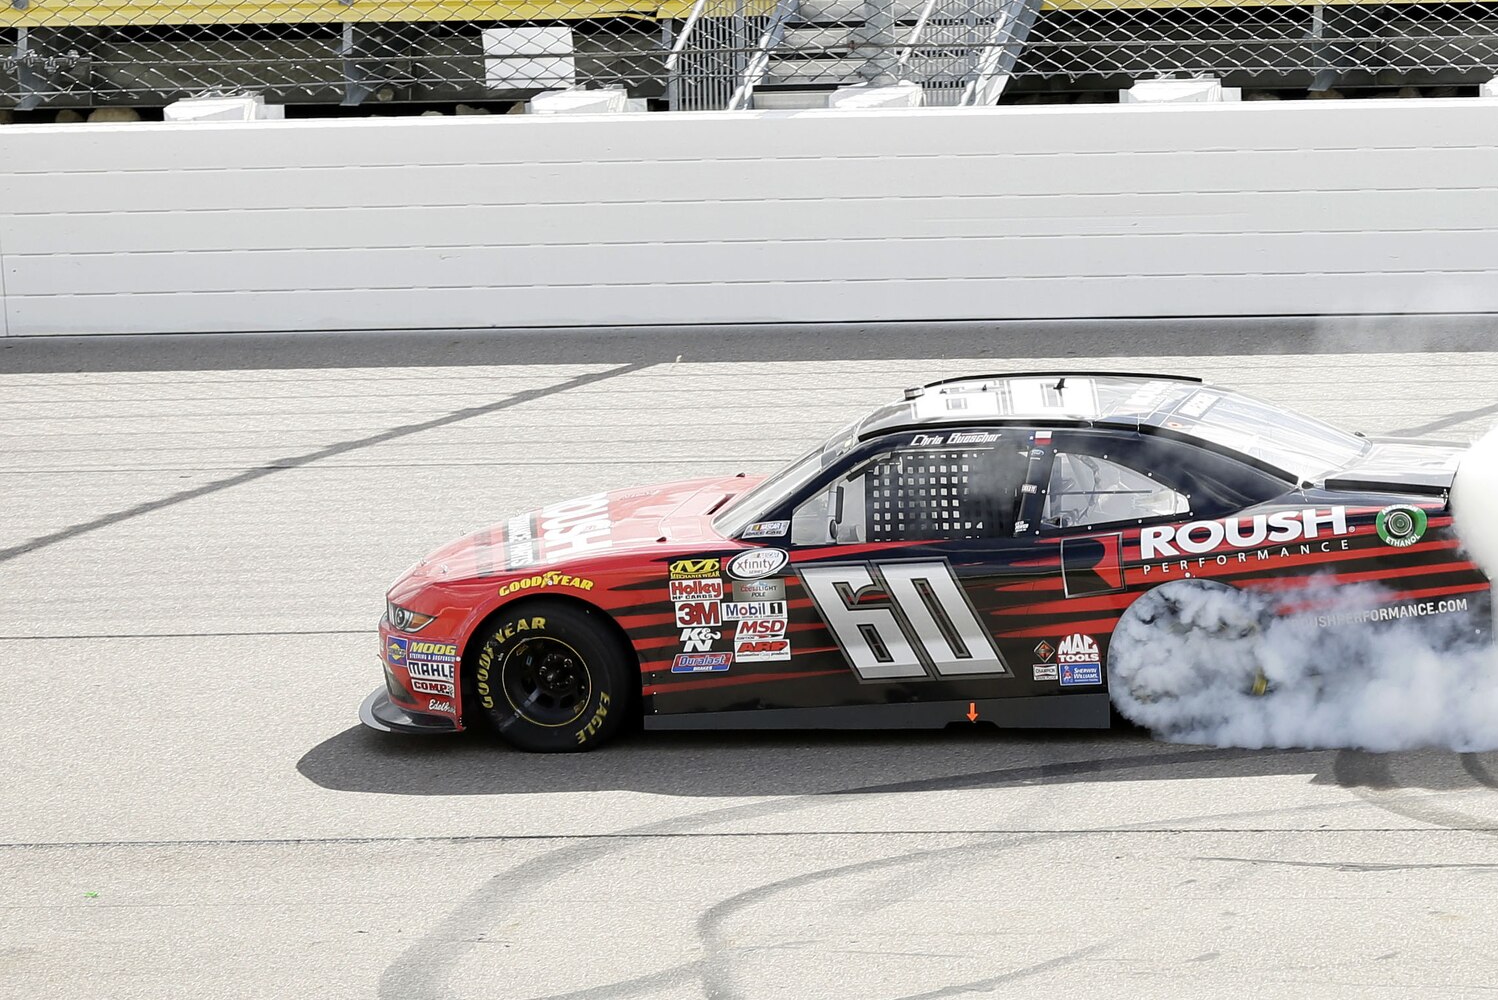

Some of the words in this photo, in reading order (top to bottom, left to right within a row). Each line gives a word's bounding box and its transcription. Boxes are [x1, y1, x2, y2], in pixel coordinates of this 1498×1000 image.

[910, 434, 944, 446] Chris
[946, 432, 1002, 444] Buescher
[1140, 506, 1347, 560] ROUSH
[1385, 533, 1421, 547] ETHANOL
[737, 559, 775, 572] xfinity
[1143, 540, 1350, 575] PERFORMANCE
[499, 571, 594, 597] GOODYEAR
[671, 581, 722, 598] Holley
[678, 602, 719, 626] 3M
[725, 603, 766, 616] Mobil
[739, 620, 785, 634] MSD
[797, 559, 1008, 681] 60
[410, 642, 457, 655] MOOG
[737, 641, 789, 653] ARP
[1058, 633, 1099, 654] MAC
[477, 616, 547, 709] GOODYEAR
[680, 654, 727, 666] Duralast
[1058, 654, 1099, 662] TOOLS
[408, 661, 455, 678] MAHLE
[575, 691, 610, 745] EAGLE
